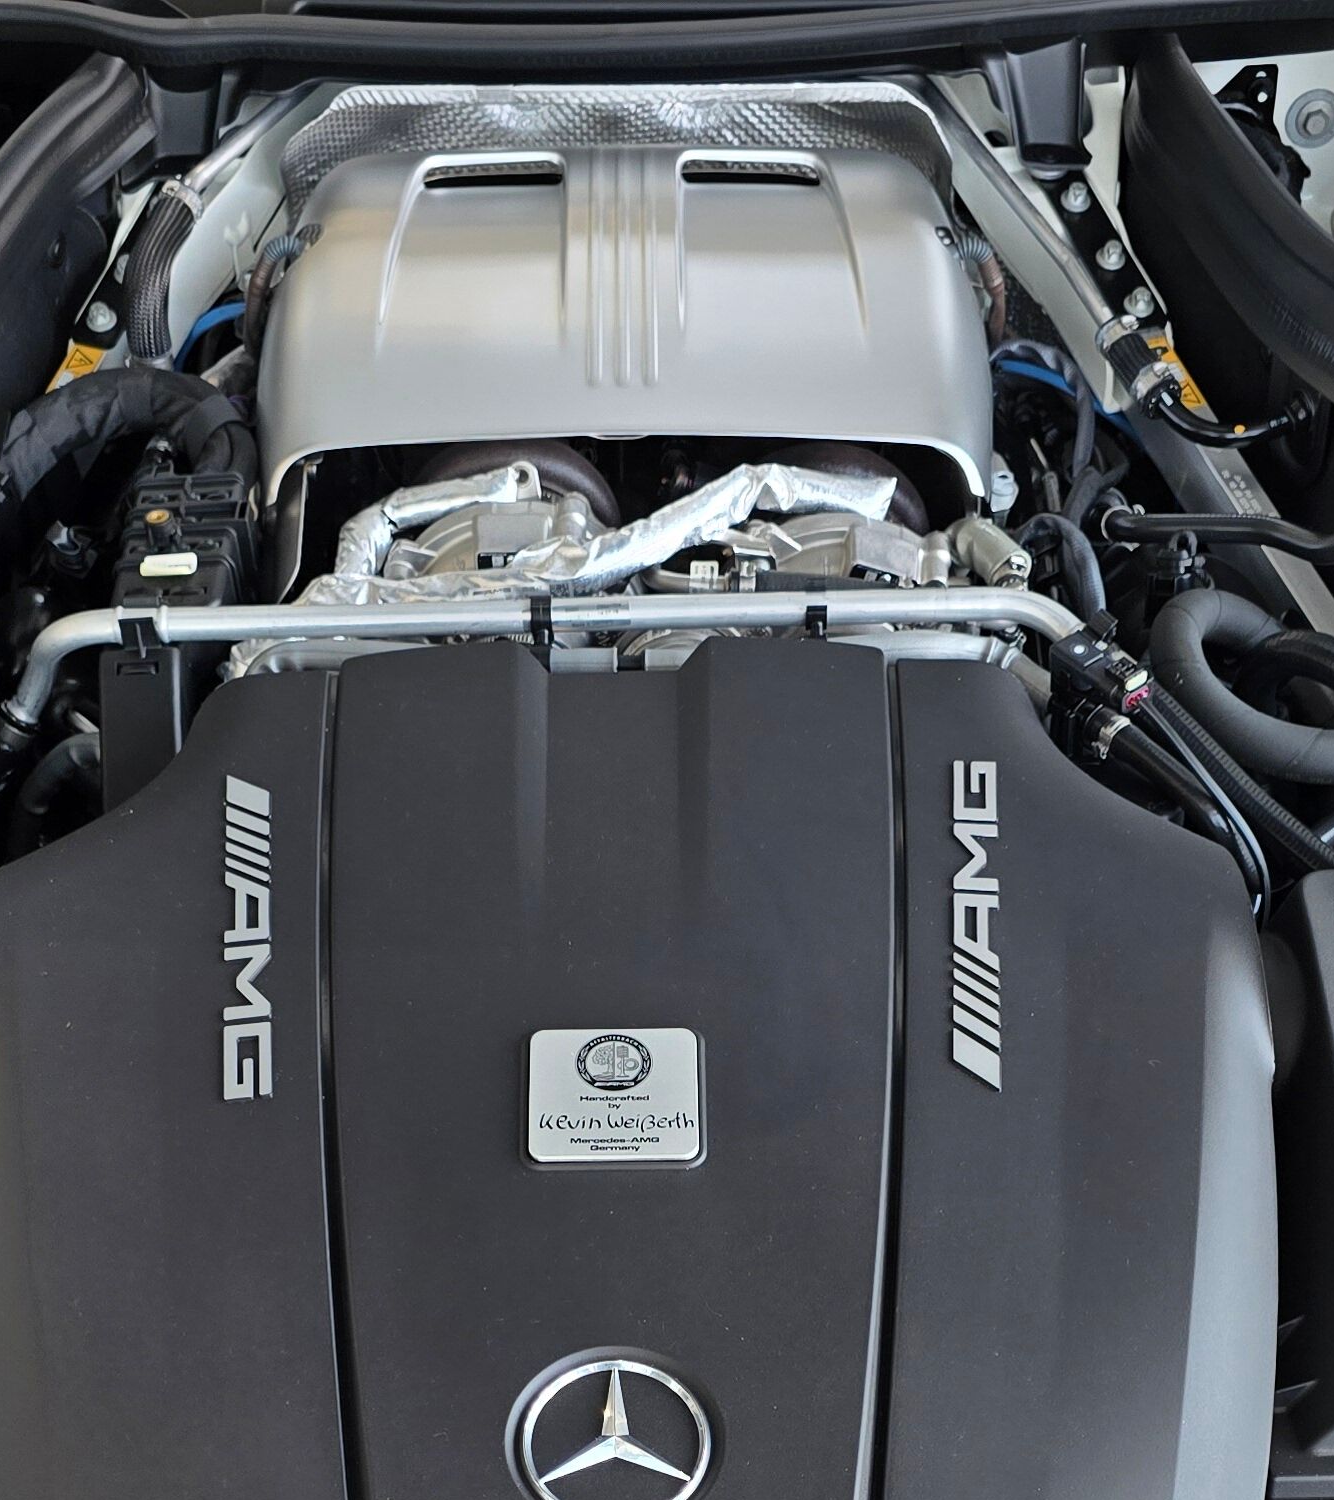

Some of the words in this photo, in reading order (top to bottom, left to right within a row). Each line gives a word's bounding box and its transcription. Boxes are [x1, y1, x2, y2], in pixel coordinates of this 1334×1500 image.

[579, 1094, 650, 1102] Handcrafted
[608, 1102, 621, 1110] by
[590, 1144, 640, 1152] Germany
